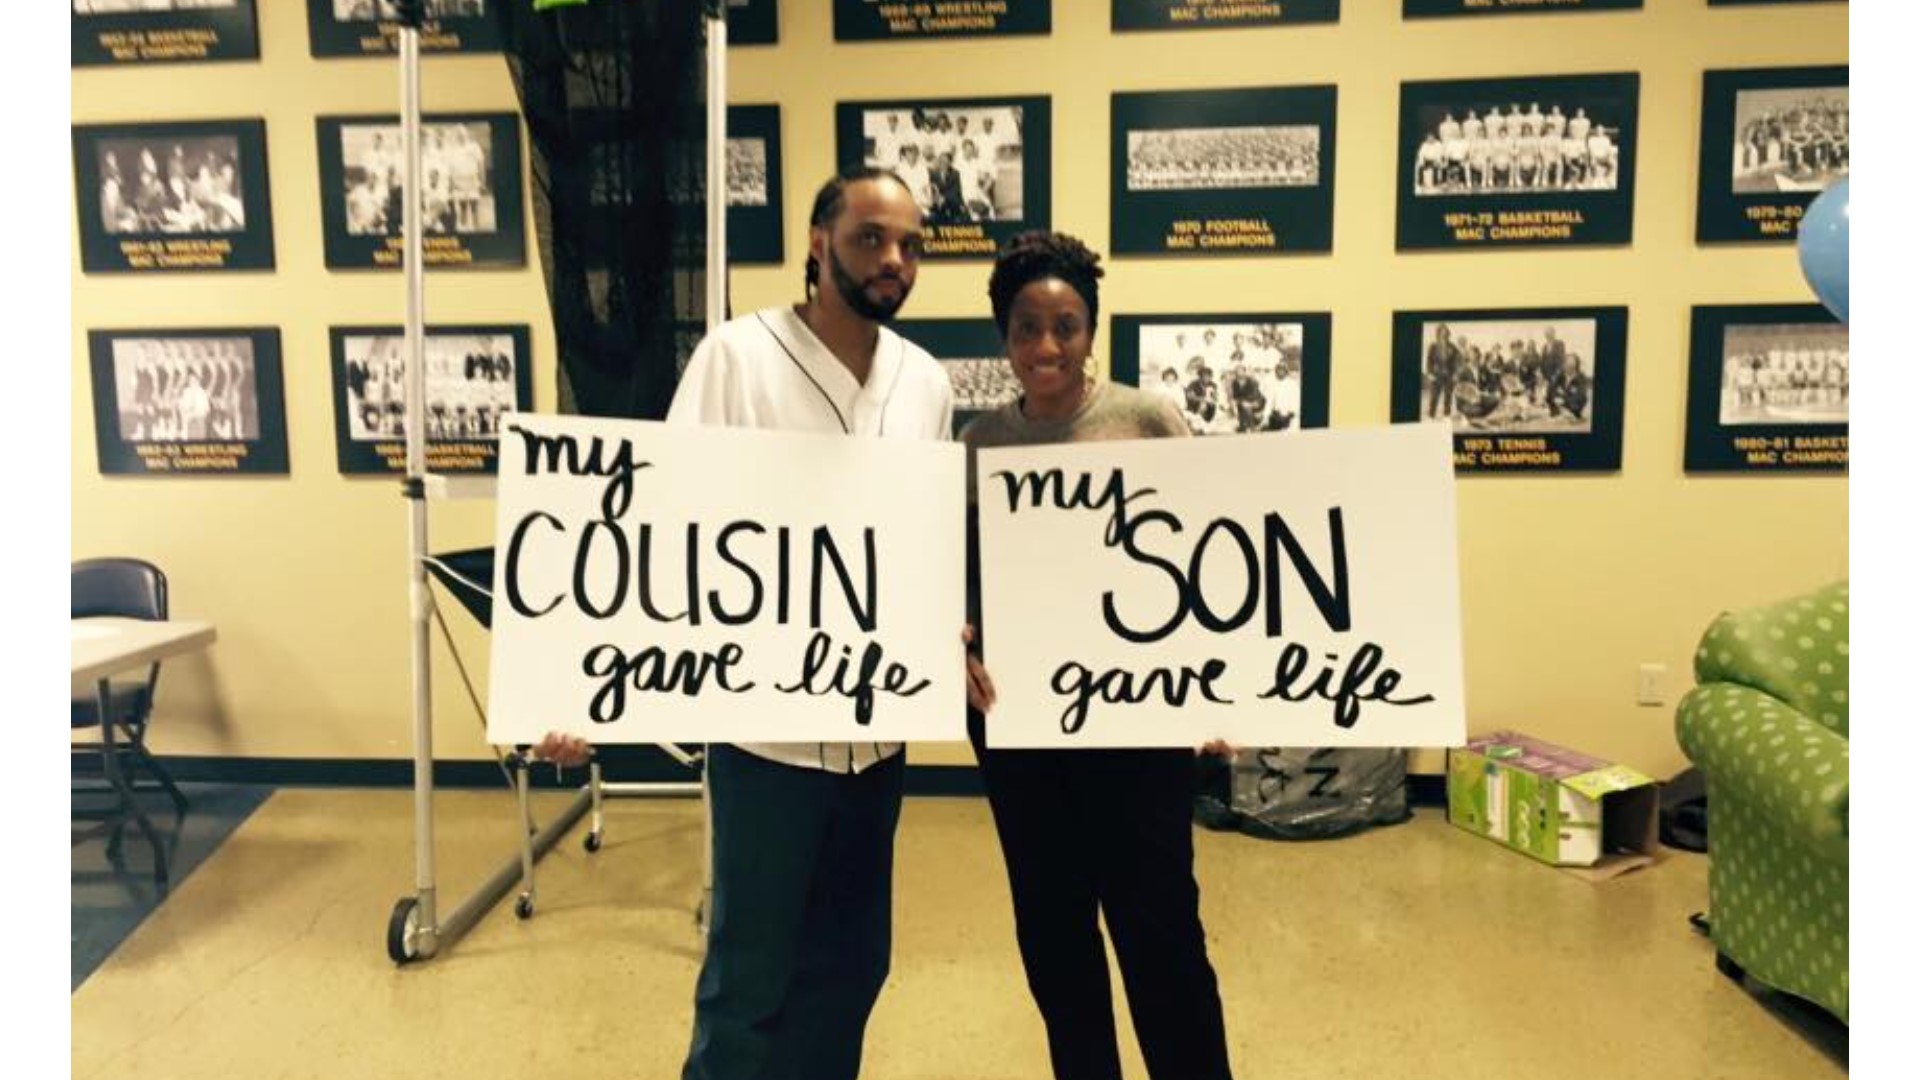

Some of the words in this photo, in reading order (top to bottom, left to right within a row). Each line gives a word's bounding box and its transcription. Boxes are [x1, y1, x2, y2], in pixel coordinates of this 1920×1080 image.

[934, 2, 1006, 13] WRESTLING
[1170, 6, 1198, 20] MAC
[1203, 3, 1281, 18] CHAMPIONS
[890, 19, 917, 31] MAC
[921, 15, 995, 30] CHAMPIONS
[1498, 210, 1584, 224] BASKETBALL
[938, 226, 983, 238] TENNIS
[1173, 220, 1201, 233] 1970
[1205, 219, 1272, 233] FOOTBALL
[1456, 228, 1485, 240] MAC
[1489, 225, 1571, 240] CHAMPIONS
[1760, 220, 1791, 233] MAC
[923, 239, 996, 253] CHAMPIONS
[1166, 235, 1196, 248] MAC
[1199, 233, 1275, 247] CHAMPIONS
[1498, 437, 1546, 450] TENNIS
[1481, 451, 1561, 464] CHAMPIONS
[1747, 452, 1778, 463] MAC
[508, 425, 654, 520] my
[990, 468, 1157, 546] my
[505, 511, 877, 632] COUSIN
[1102, 506, 1351, 643] SON
[582, 642, 756, 724] gave
[775, 630, 931, 726] life
[1051, 658, 1234, 734] gave
[1258, 642, 1435, 728] life
